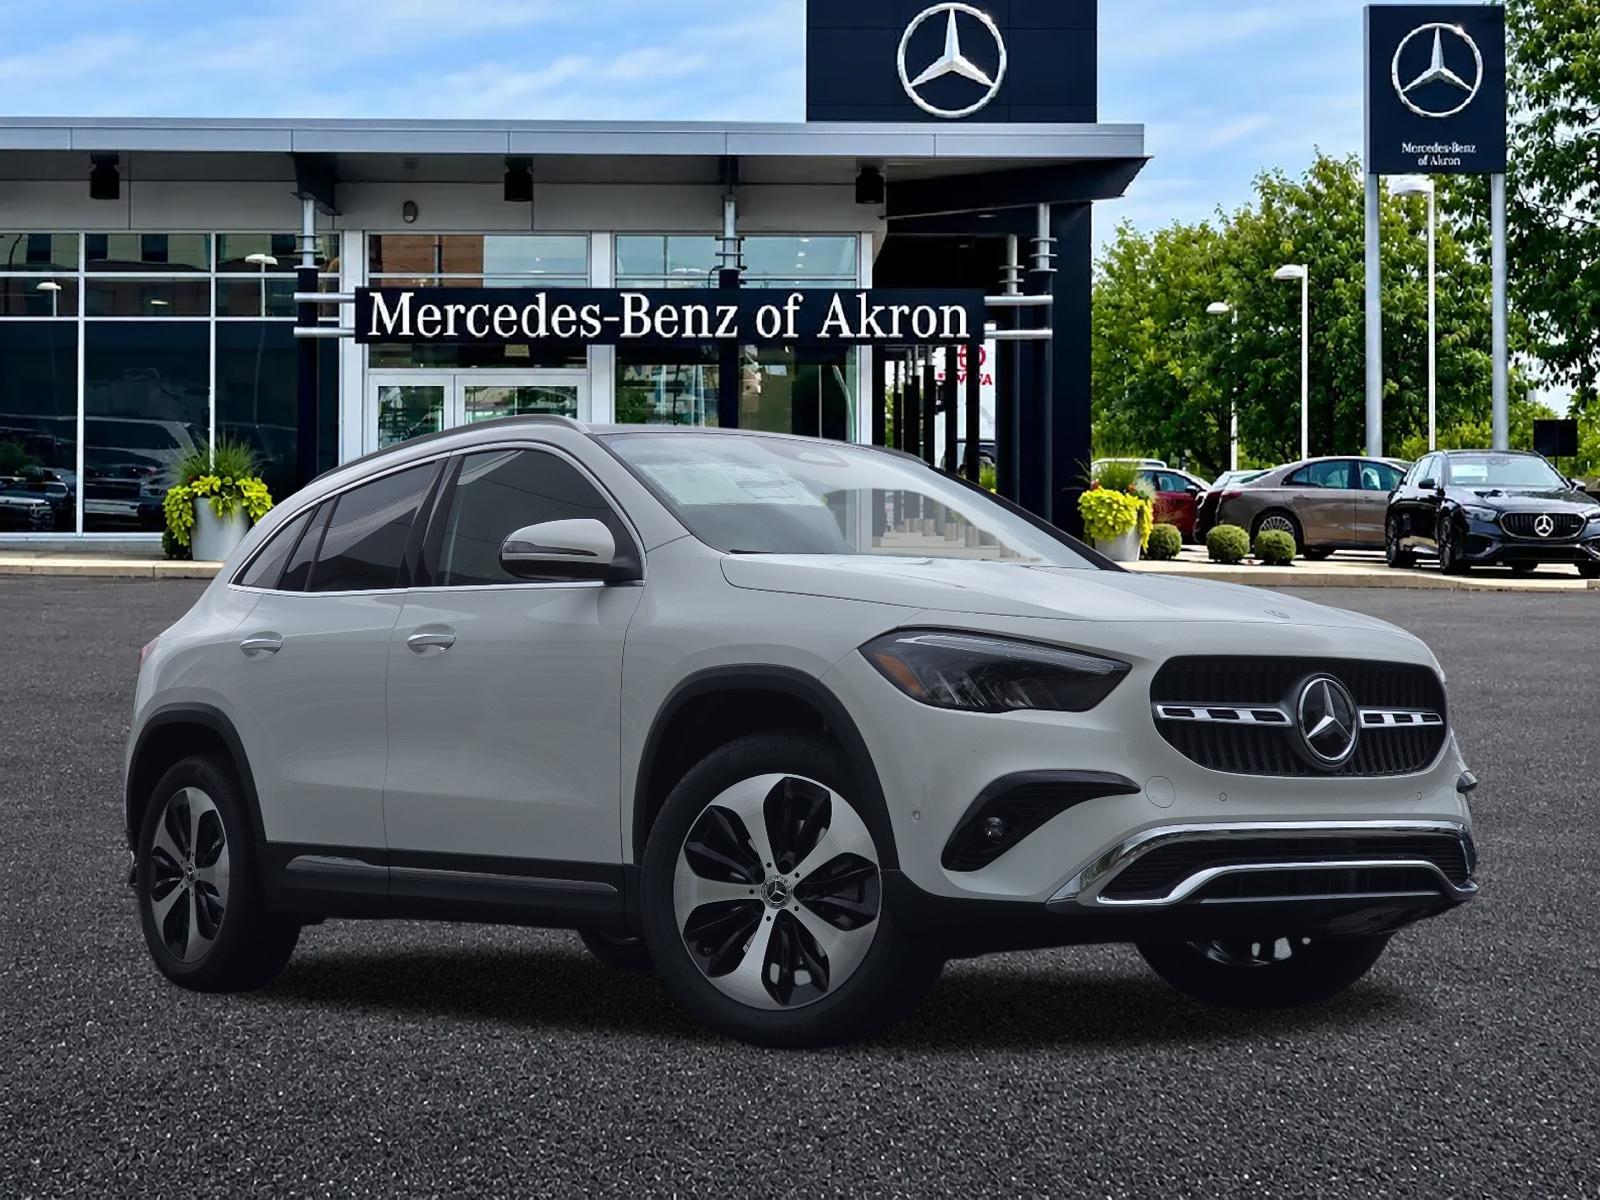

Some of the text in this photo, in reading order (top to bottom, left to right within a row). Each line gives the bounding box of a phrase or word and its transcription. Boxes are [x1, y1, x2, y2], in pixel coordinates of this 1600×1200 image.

[1401, 141, 1477, 154] Mercedes-Benz
[1417, 154, 1461, 166] of Akron
[367, 291, 971, 339] Mercedes-Benz of Akron
